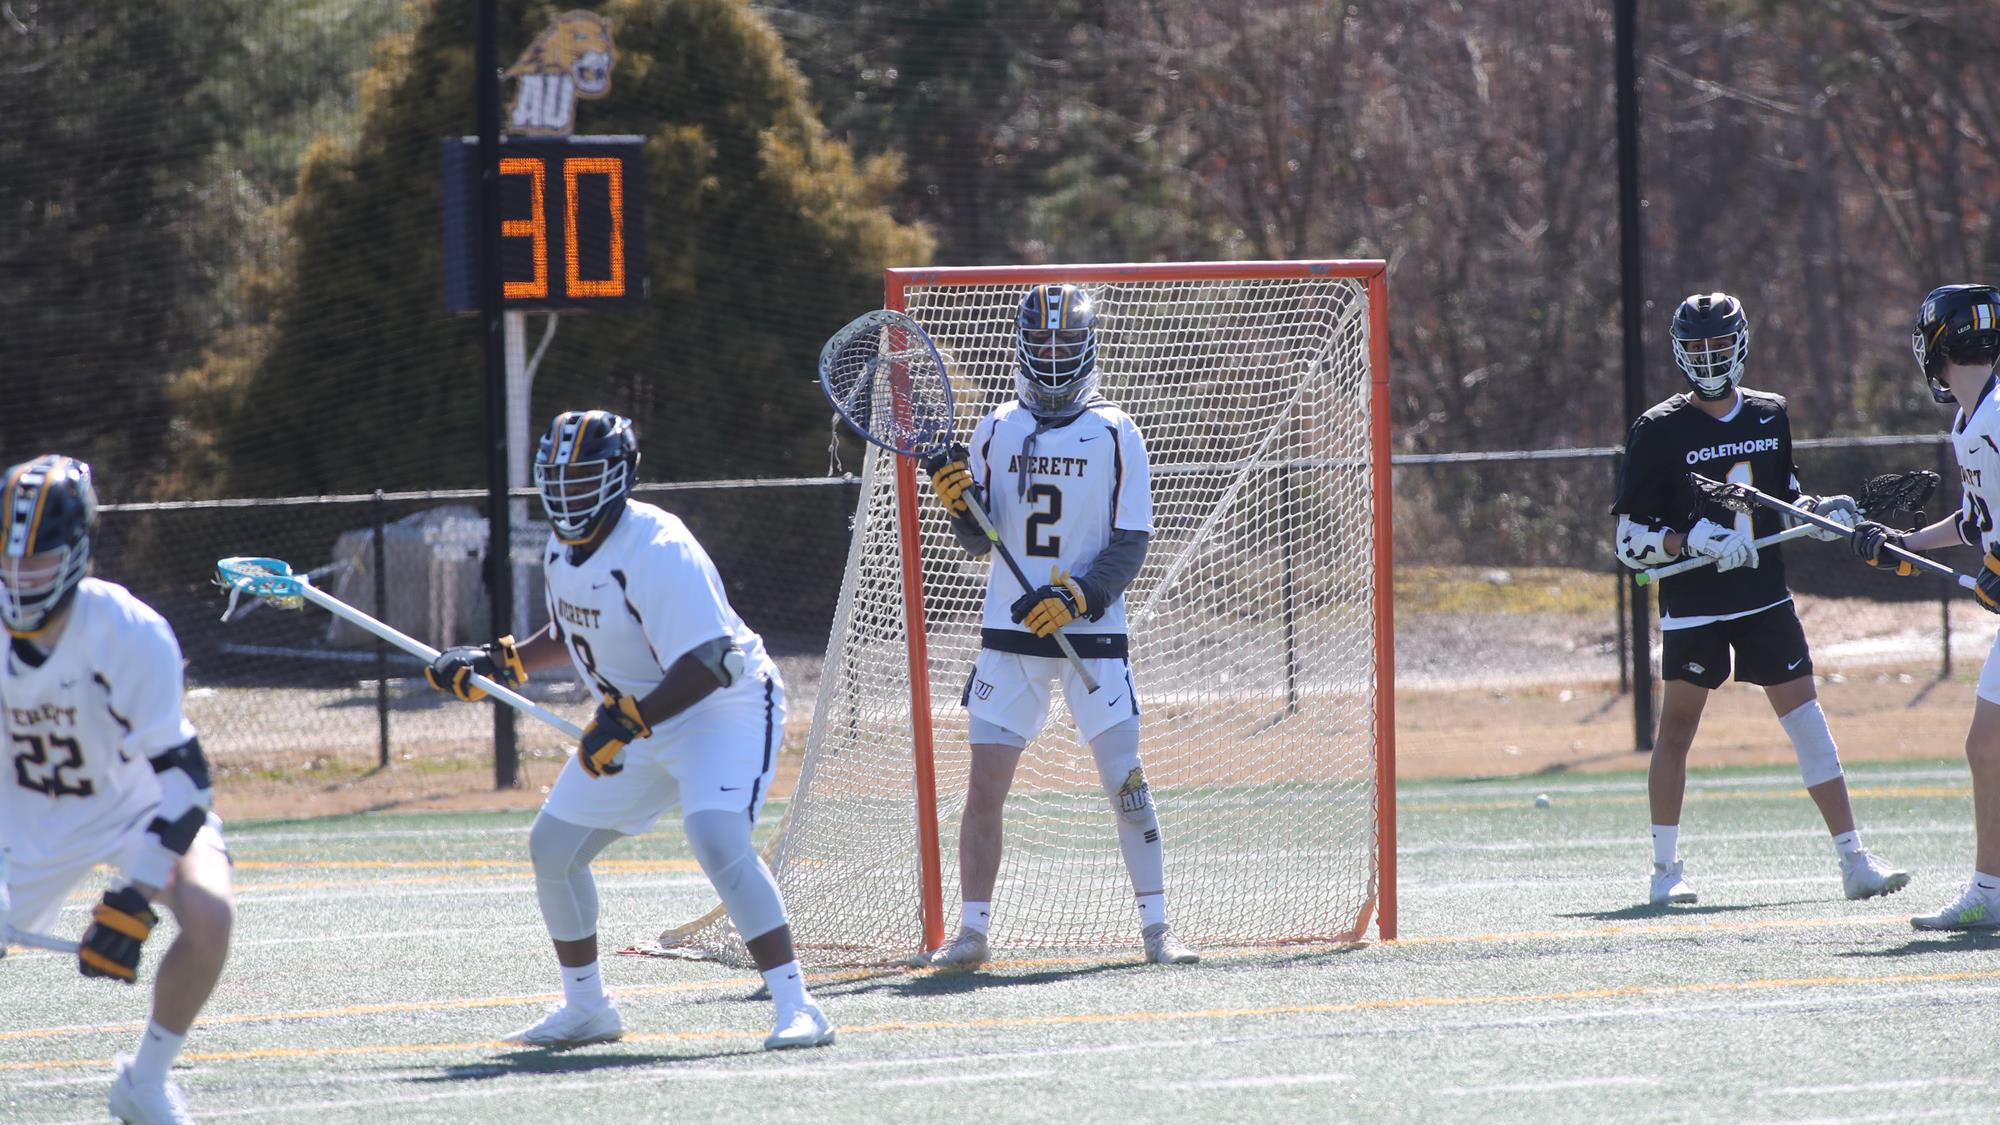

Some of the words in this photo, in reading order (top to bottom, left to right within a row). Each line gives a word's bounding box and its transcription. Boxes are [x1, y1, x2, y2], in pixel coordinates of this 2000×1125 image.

[499, 157, 625, 299] 30
[1686, 438, 1779, 465] OGLETHORPE
[1026, 483, 1062, 558] 2
[12, 733, 95, 798] 22
